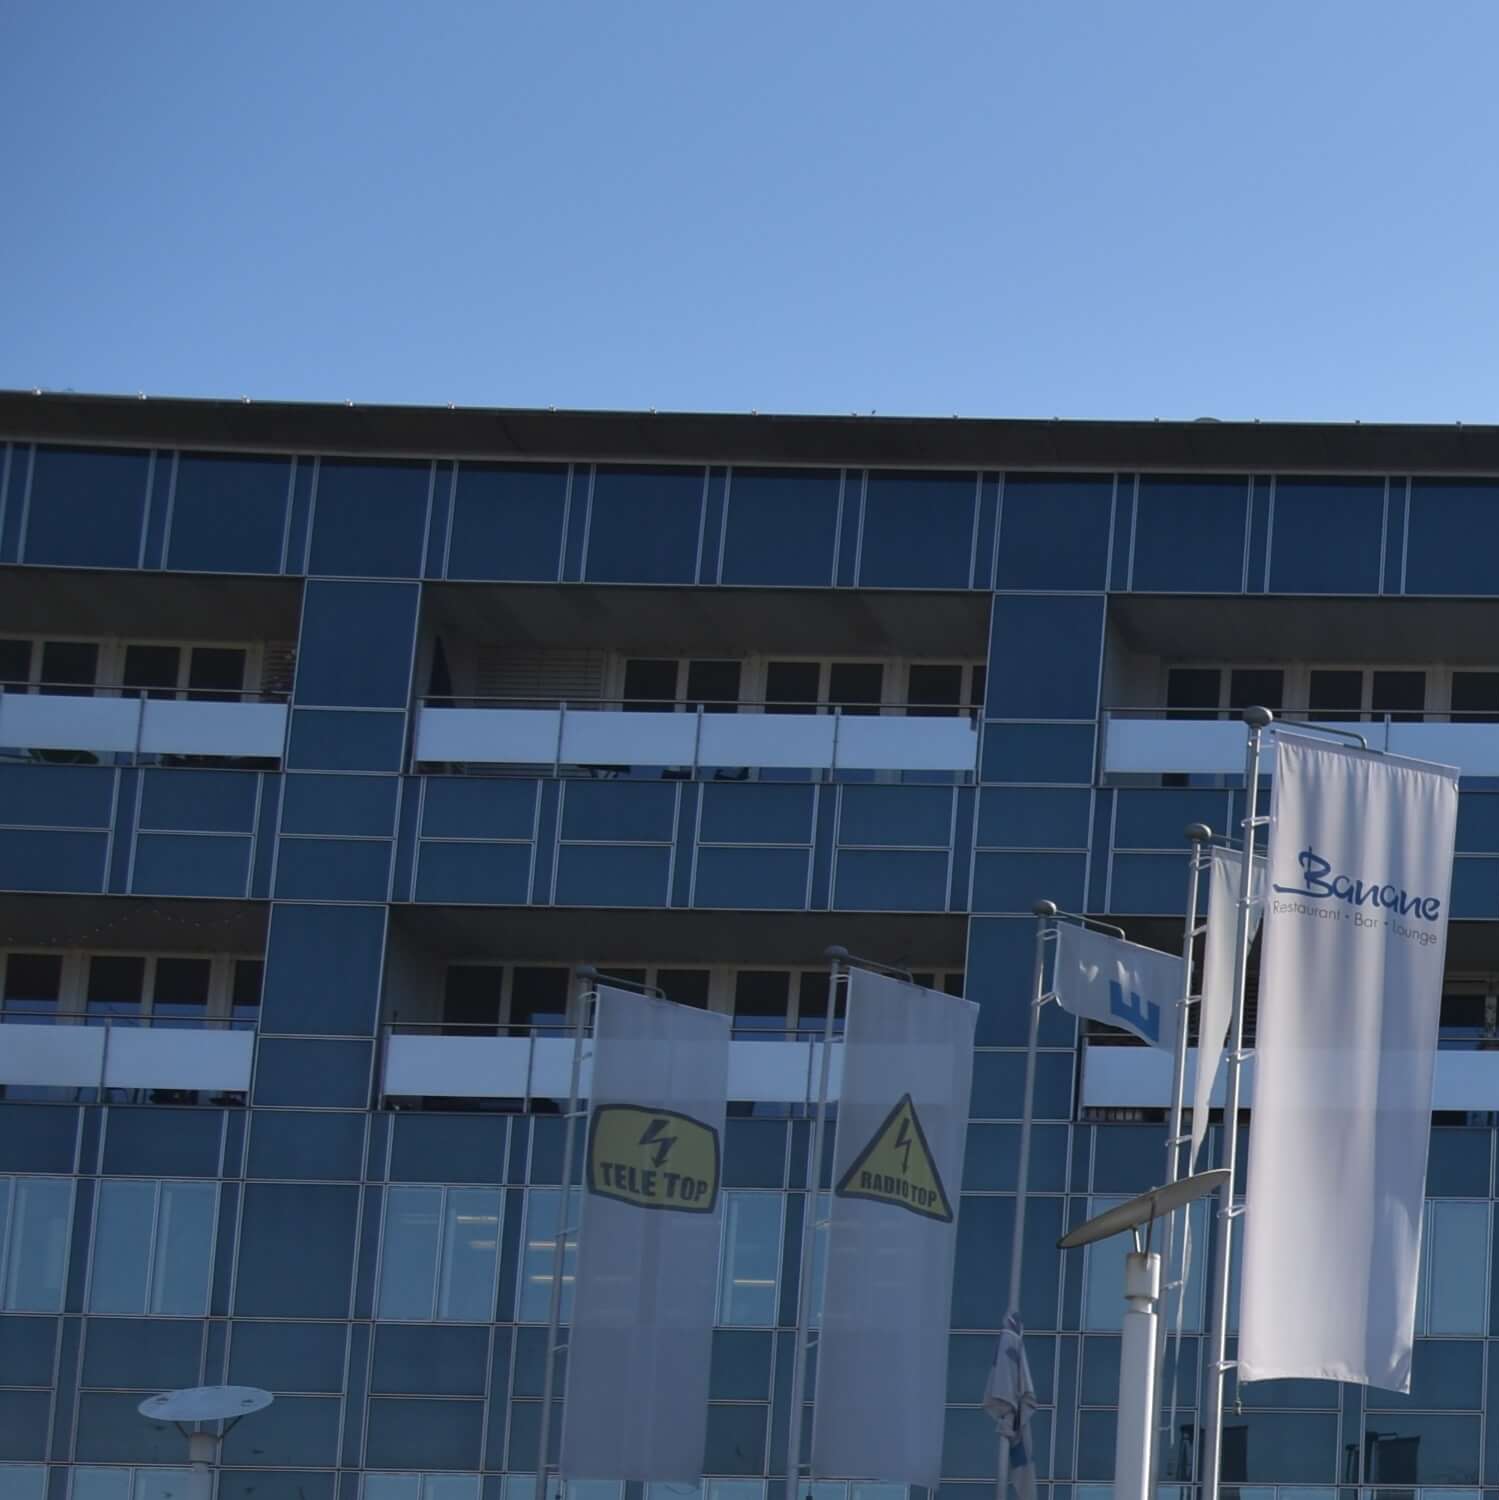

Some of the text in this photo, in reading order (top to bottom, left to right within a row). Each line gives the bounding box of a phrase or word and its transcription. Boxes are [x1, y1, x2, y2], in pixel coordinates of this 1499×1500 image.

[1272, 845, 1441, 922] Banane
[1272, 900, 1438, 946] Restaurant Bar Lounge
[600, 1161, 709, 1204] TELE TOP
[860, 1169, 938, 1208] RADIO TOP
